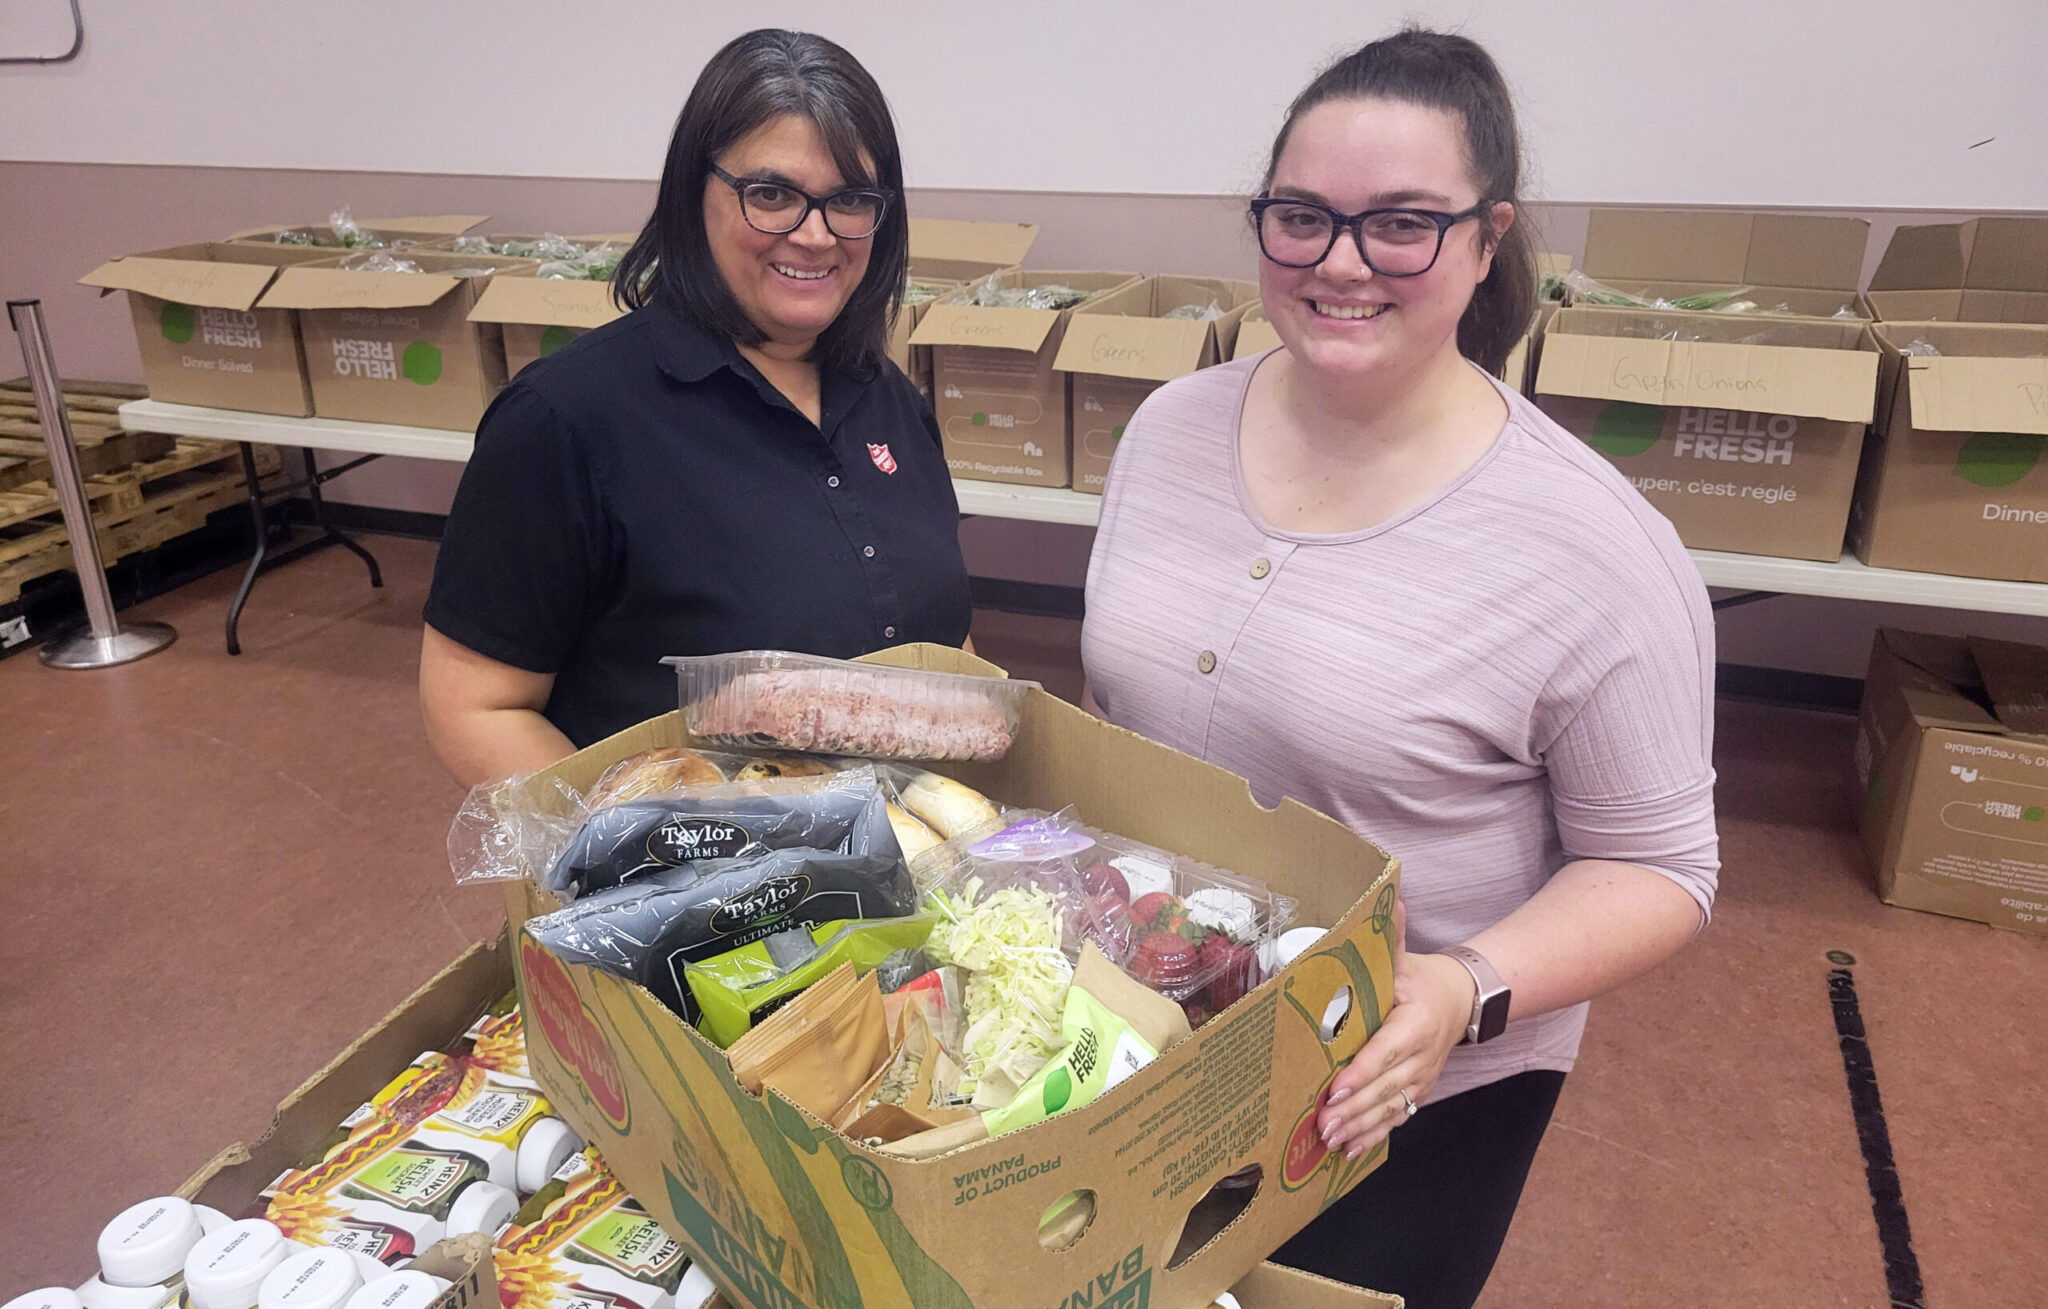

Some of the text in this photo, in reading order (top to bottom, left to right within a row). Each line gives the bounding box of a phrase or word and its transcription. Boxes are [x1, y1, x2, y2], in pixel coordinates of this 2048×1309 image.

[200, 308, 258, 329] HELLO
[203, 325, 262, 348] FRESH
[1091, 332, 1145, 364] Greens
[332, 338, 395, 360] FRESH
[182, 355, 215, 370] Dinner
[335, 357, 398, 380] HELLO
[1695, 369, 1769, 391] Onions
[1676, 407, 1798, 440] HELLO
[1673, 432, 1795, 466] FRESH
[975, 461, 1024, 476] Recyclable
[1025, 466, 1044, 477] Box
[1687, 479, 1737, 497] c'est
[1741, 484, 1797, 505] réglé
[1983, 503, 2048, 524] Dinne
[1944, 742, 2015, 760] recyclable
[1984, 807, 2020, 820] HELLO
[1986, 800, 2022, 813] FRESH
[661, 825, 735, 848] Taylor
[677, 846, 719, 859] FARMS
[724, 881, 798, 919] Taylor
[744, 902, 786, 924] FARMS
[733, 918, 795, 946] ULTIMATE
[462, 1093, 499, 1123] MOUTARDE
[473, 1097, 504, 1123] MUSTARD
[1253, 1087, 1269, 1110] NET
[493, 1101, 525, 1128] HEINZ
[1228, 1101, 1268, 1142] MINIMUM
[1234, 1103, 1250, 1124] WT.
[1210, 1128, 1219, 1143] lb
[1221, 1118, 1232, 1136] 40
[1235, 1125, 1267, 1162] CLASS:
[1287, 1132, 1322, 1170] nte
[1169, 1114, 1267, 1201] VARIETY: CAVENDISH
[1183, 1135, 1226, 1176] LENGTH:
[390, 1157, 436, 1194] RELISH
[412, 1167, 435, 1187] SWEET
[953, 1151, 1024, 1192] PANAMA
[954, 1153, 1061, 1207] PRODUCT OF
[1162, 1158, 1177, 1179] kg)
[1169, 1170, 1181, 1187] 20
[420, 1166, 457, 1197] HEINZ
[1152, 1181, 1167, 1197] cm
[617, 1219, 659, 1260] RELISH
[639, 1232, 660, 1254] SWEET
[648, 1235, 679, 1266] EINZ
[1059, 1243, 1144, 1309] BAN
